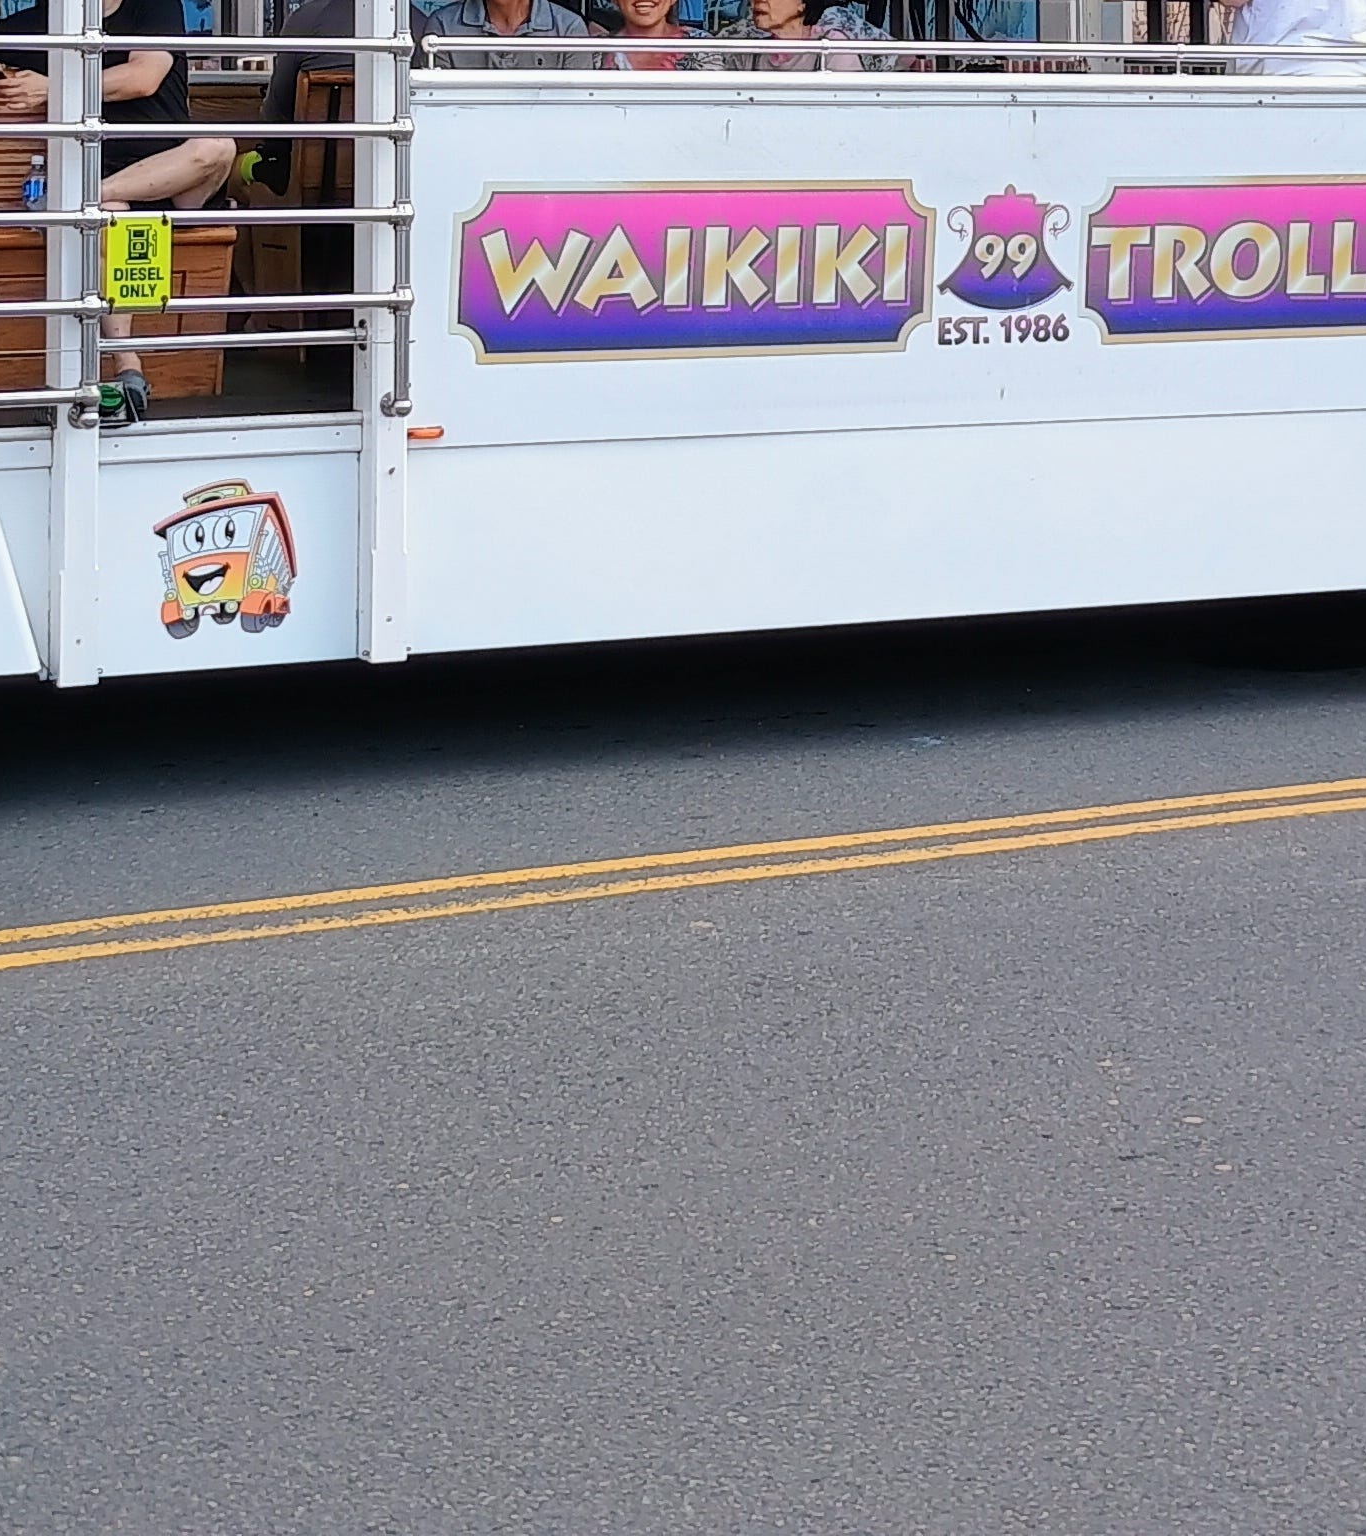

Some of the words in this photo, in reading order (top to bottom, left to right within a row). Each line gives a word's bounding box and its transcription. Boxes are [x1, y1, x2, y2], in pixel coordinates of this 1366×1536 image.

[481, 223, 913, 316] WAIKIKI
[974, 233, 1038, 281] 99
[113, 267, 165, 282] DIESEL
[119, 283, 158, 299] ONLY
[937, 316, 990, 346] EST.
[999, 312, 1070, 344] 1986
